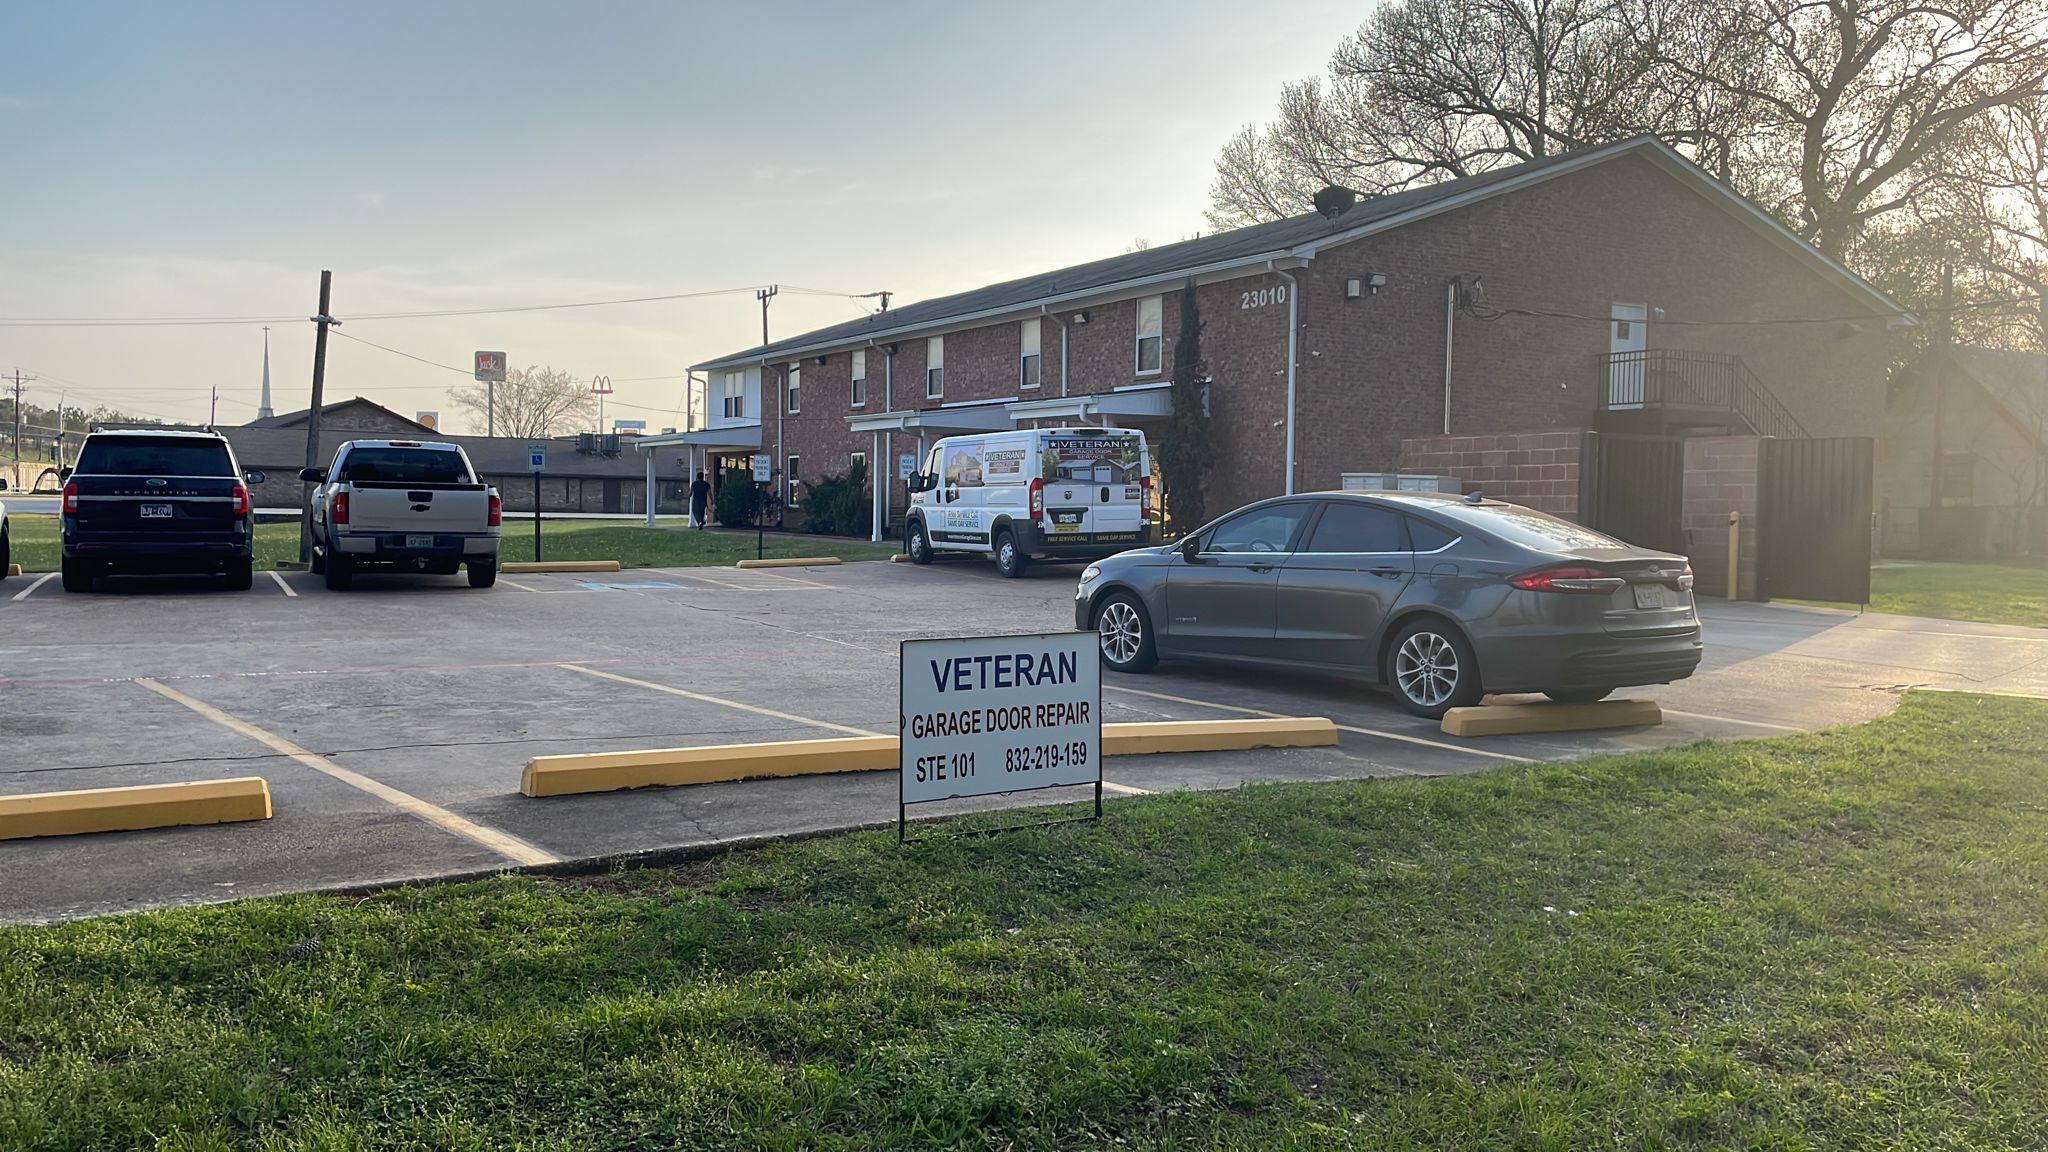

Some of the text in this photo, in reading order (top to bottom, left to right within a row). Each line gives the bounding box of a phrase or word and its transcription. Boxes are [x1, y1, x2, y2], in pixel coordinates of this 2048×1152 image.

[1241, 285, 1286, 310] 23010
[990, 450, 1020, 460] VETERAN
[1060, 440, 1120, 448] VETERAN
[931, 651, 1077, 693] VETERAN
[912, 701, 1090, 739] GARAGE DOOR REPAIR
[916, 741, 1087, 783] STE 101 832-219-159
